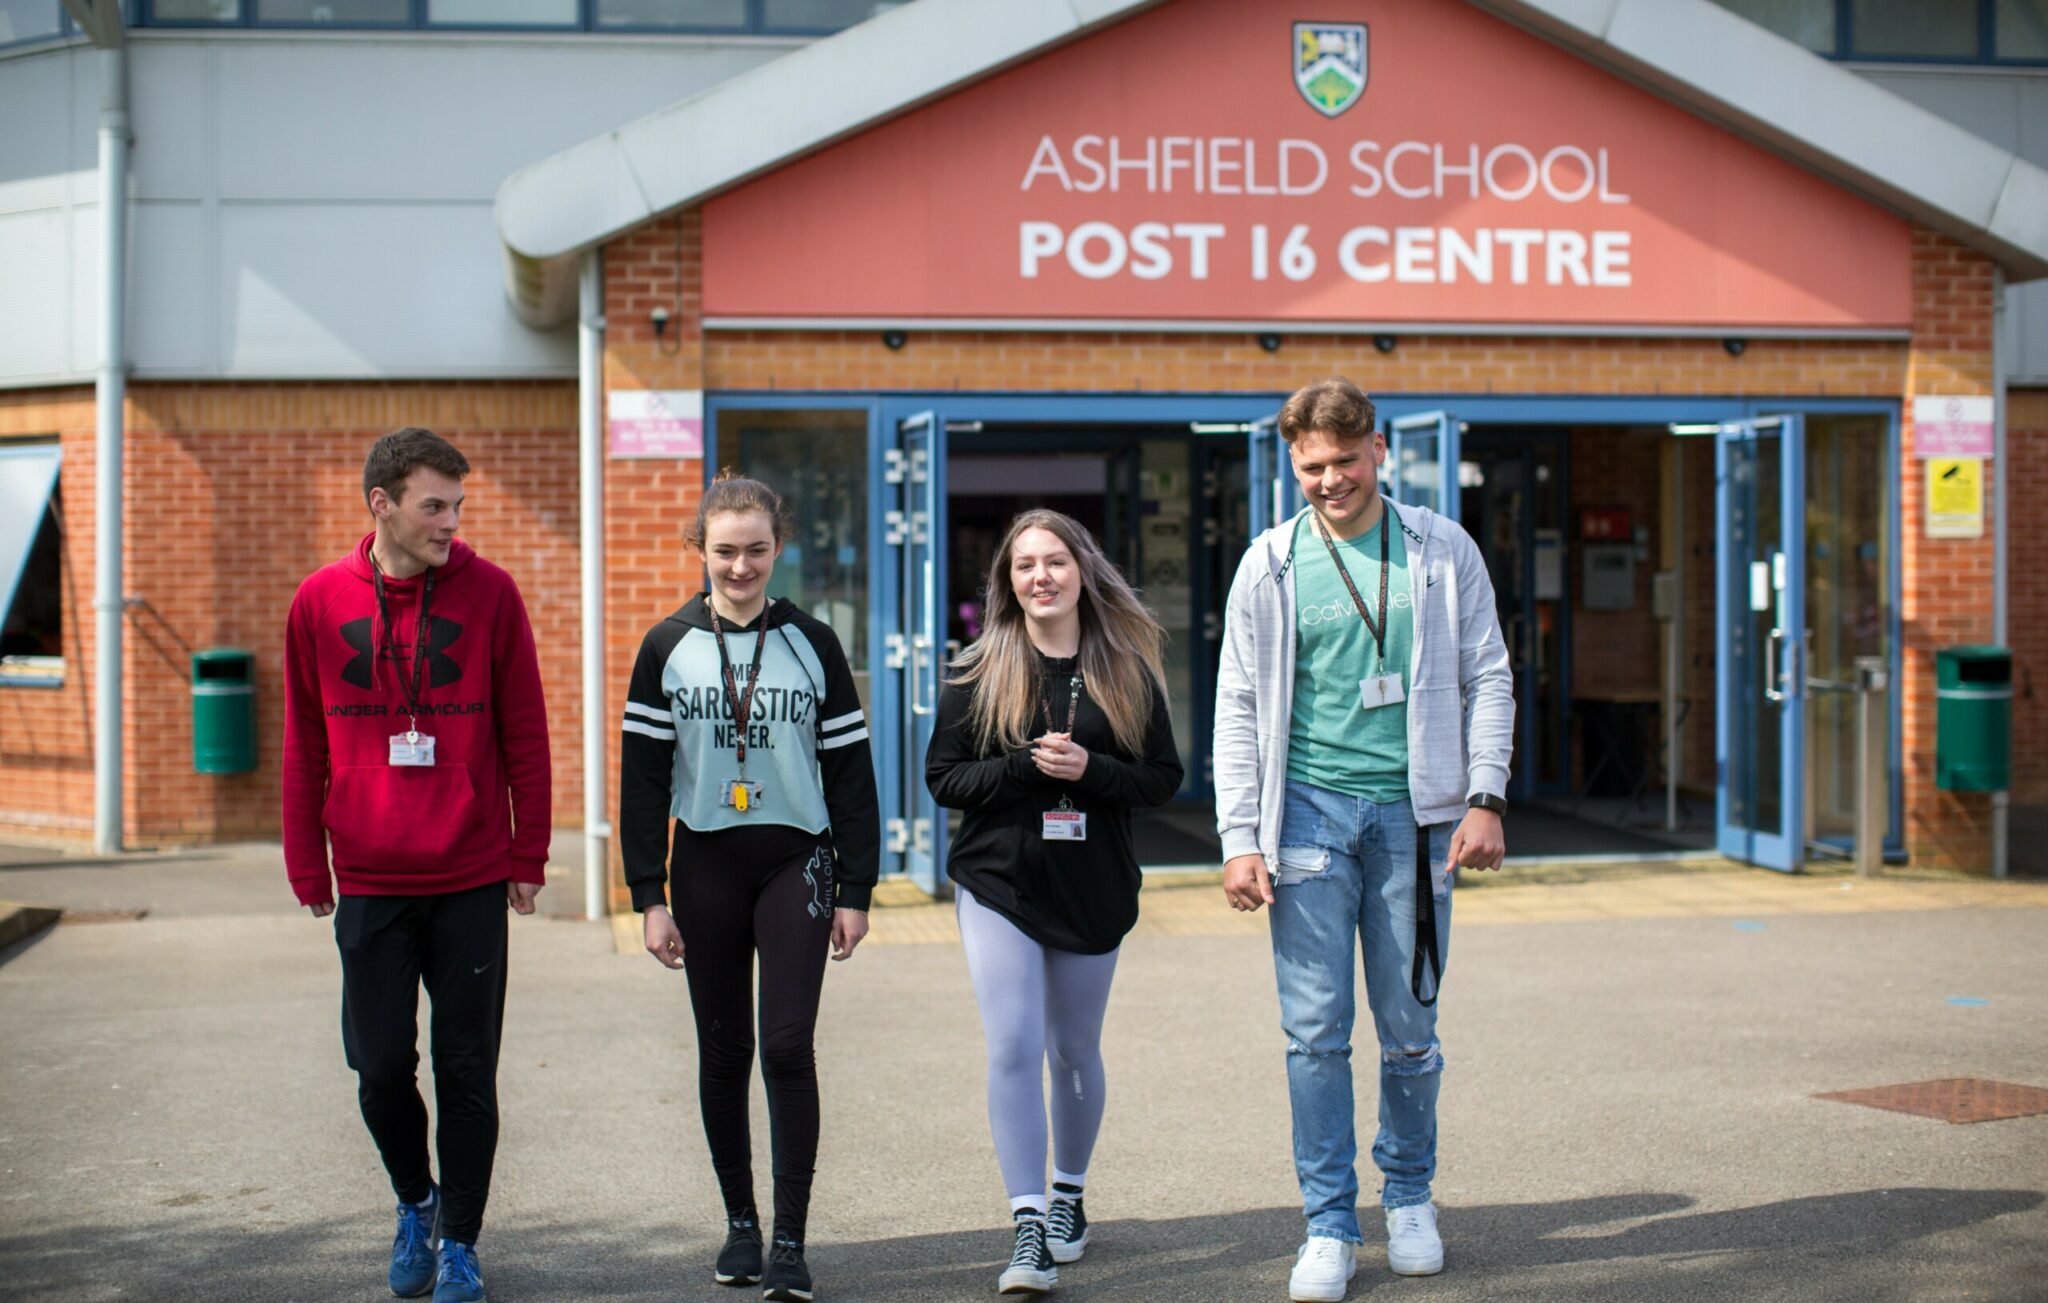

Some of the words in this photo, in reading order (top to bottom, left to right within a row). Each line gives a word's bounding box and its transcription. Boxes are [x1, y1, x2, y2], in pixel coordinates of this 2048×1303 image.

[1020, 135, 1328, 197] ASHFIELD
[1348, 140, 1631, 204] SCHOOL
[1018, 221, 1226, 280] POST
[1251, 224, 1317, 281] 16
[1338, 226, 1632, 287] CENTRE
[1372, 587, 1413, 612] Klei
[326, 704, 388, 717] UNDER
[395, 702, 485, 717] ARMOUR
[714, 724, 775, 750] NEER.
[821, 847, 833, 919] CHILLOUT
